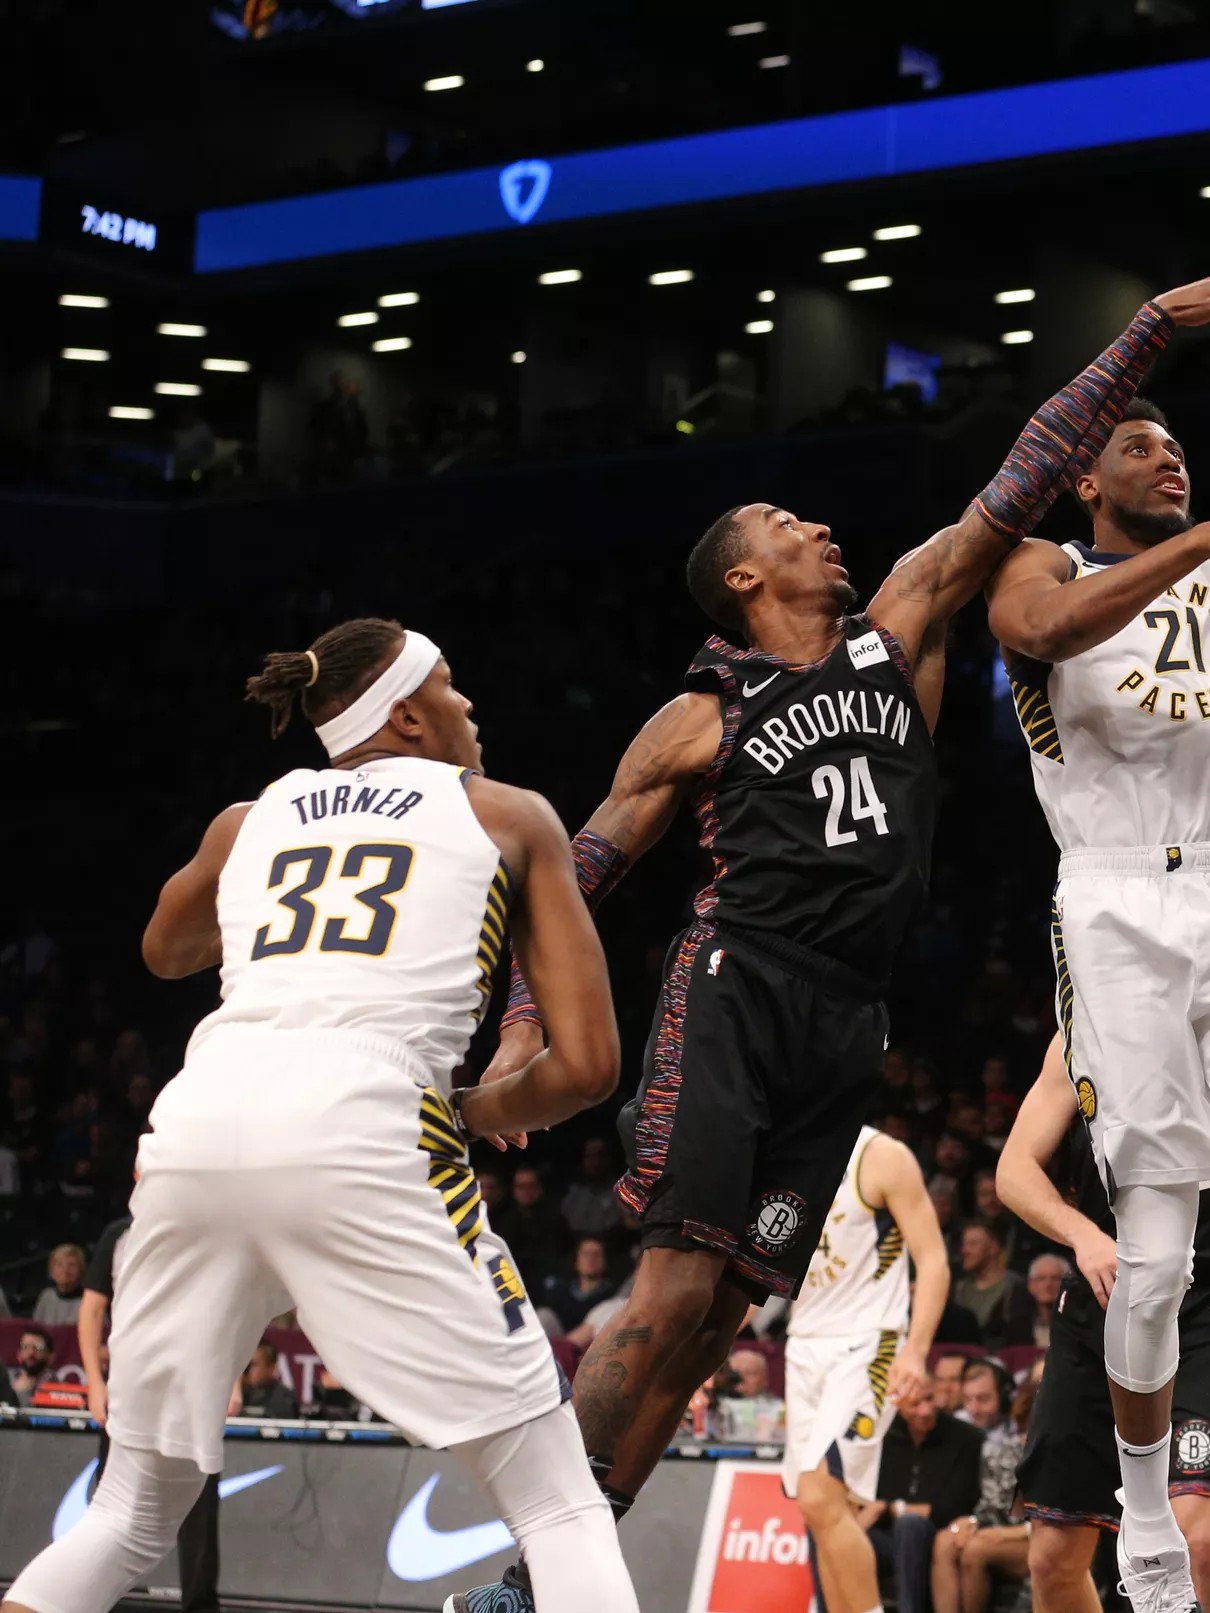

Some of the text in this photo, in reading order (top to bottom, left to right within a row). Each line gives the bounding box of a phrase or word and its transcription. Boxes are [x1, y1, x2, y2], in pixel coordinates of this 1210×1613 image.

[122, 217, 157, 251] PM
[850, 641, 880, 659] infor
[1143, 606, 1206, 674] 21
[743, 690, 912, 775] BROOKLYN
[290, 784, 424, 826] TURNER
[811, 756, 889, 848] 24
[249, 841, 415, 962] 33
